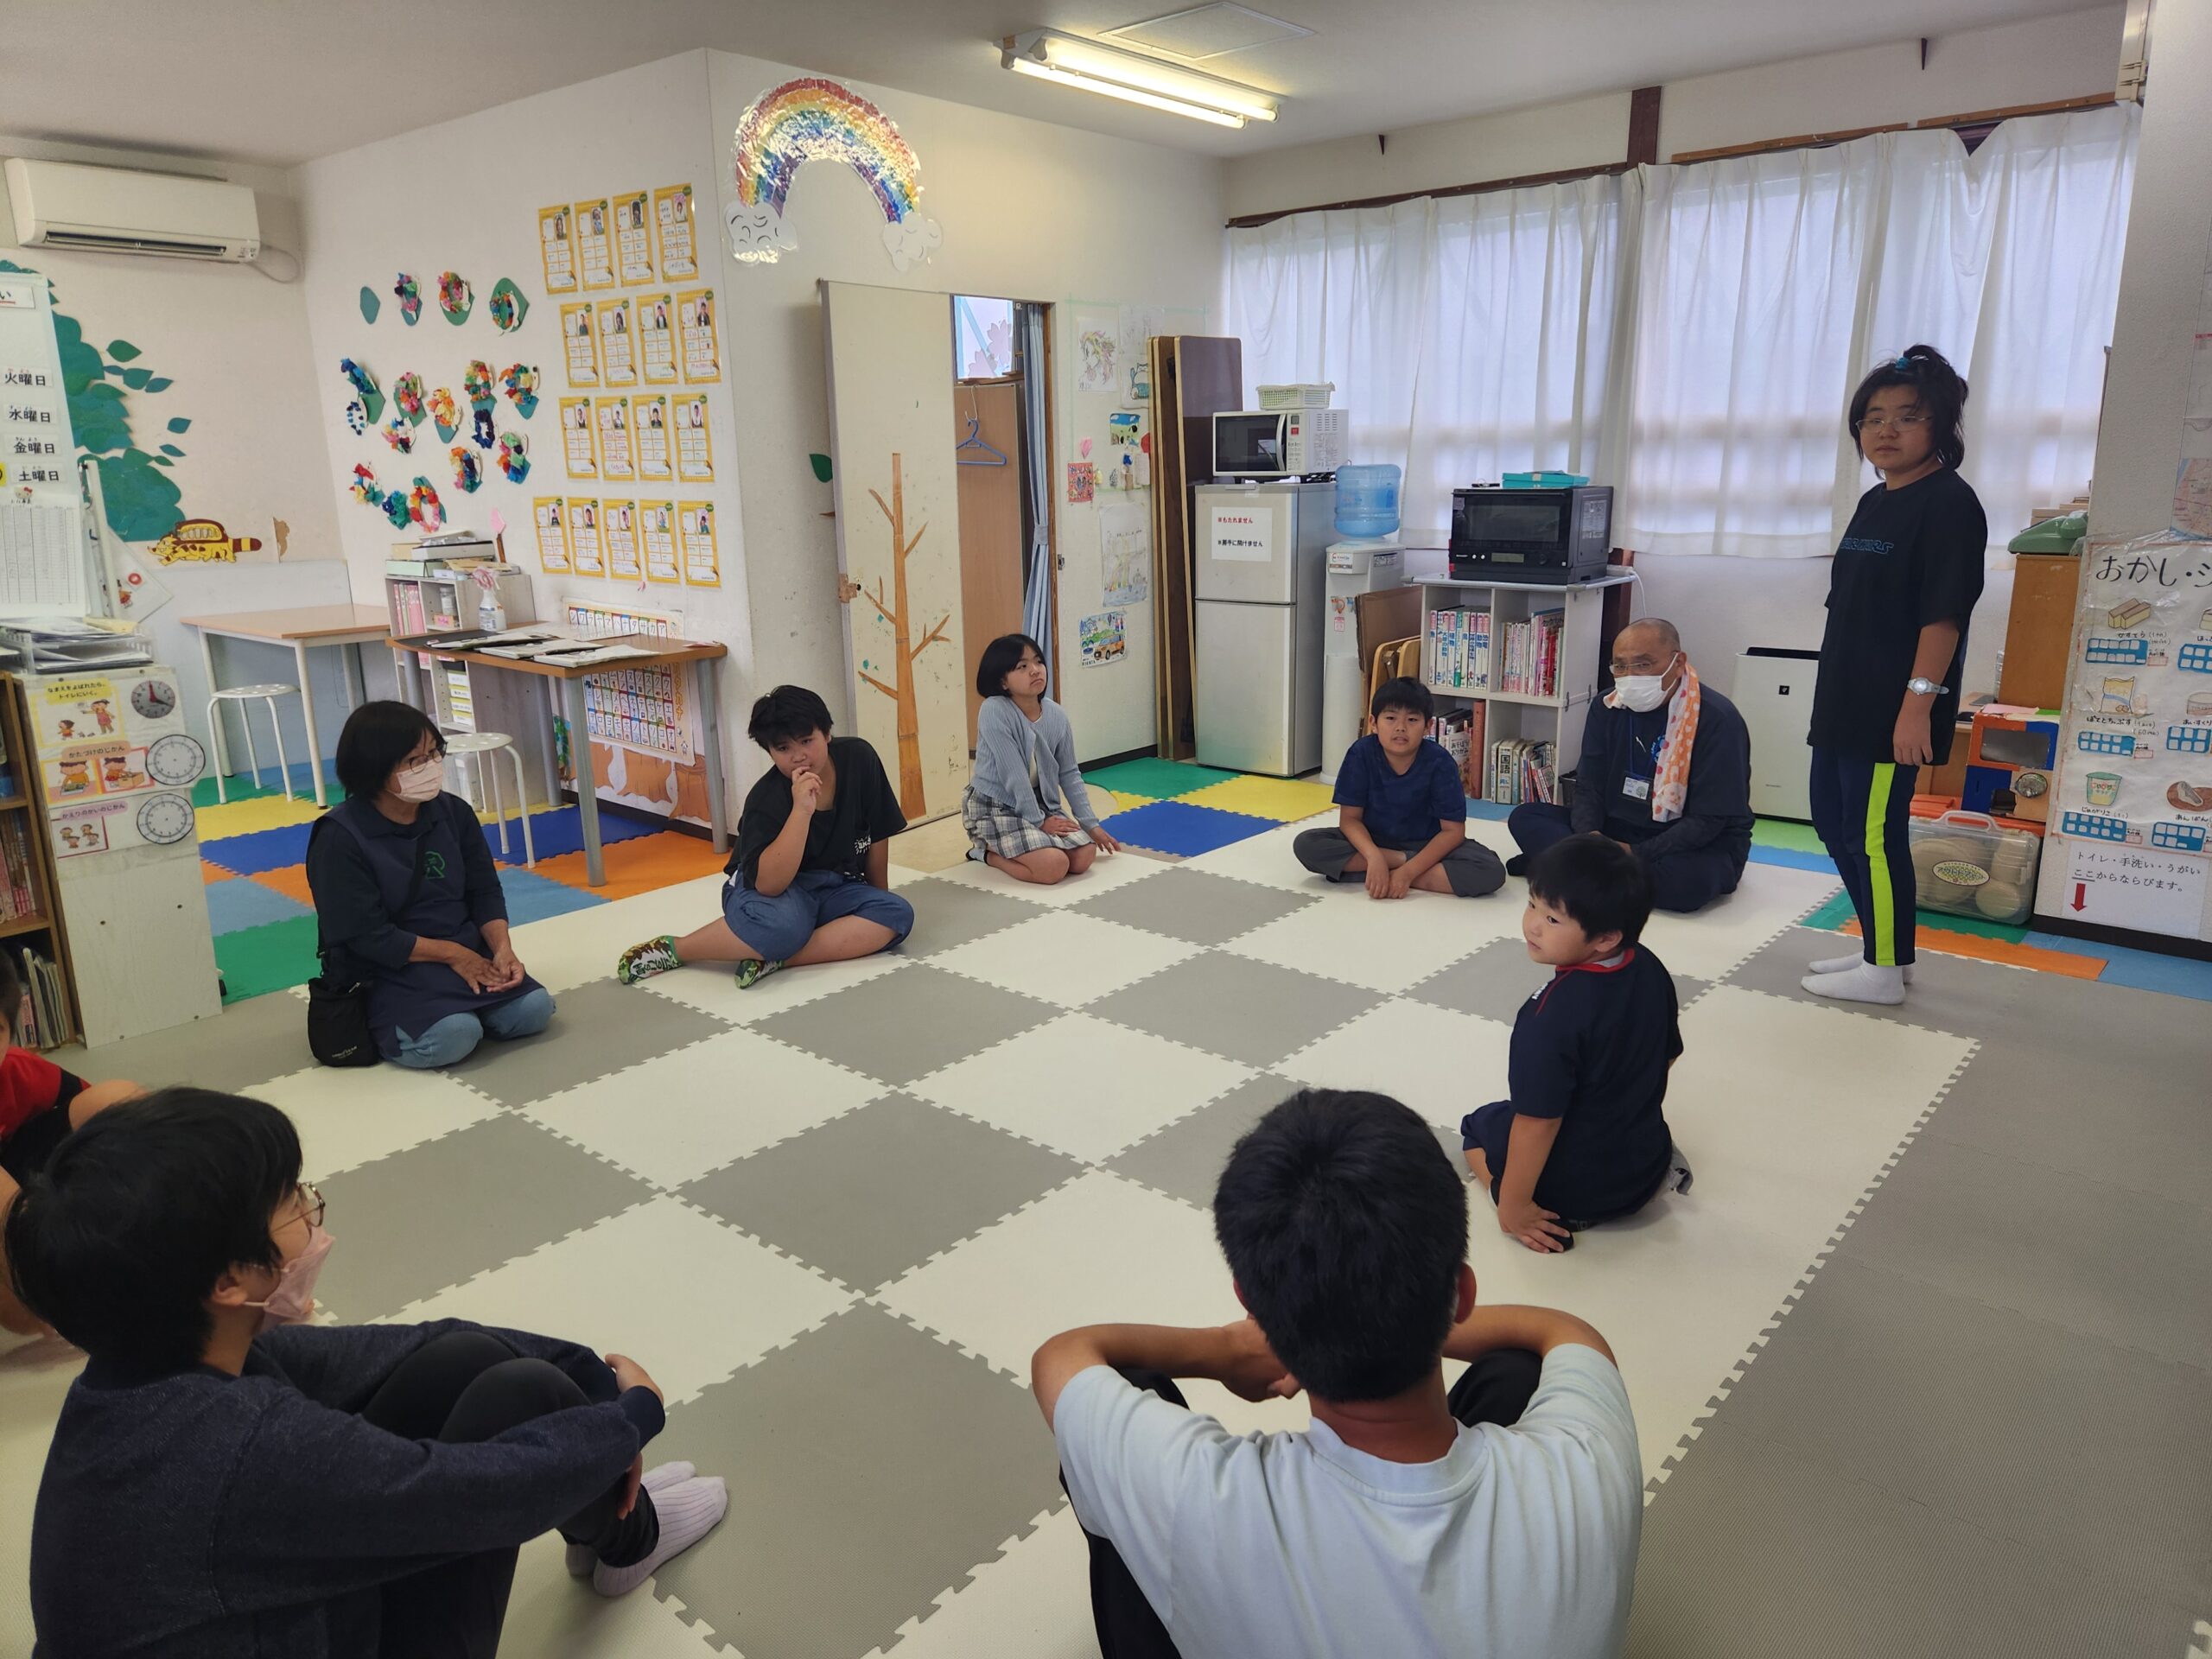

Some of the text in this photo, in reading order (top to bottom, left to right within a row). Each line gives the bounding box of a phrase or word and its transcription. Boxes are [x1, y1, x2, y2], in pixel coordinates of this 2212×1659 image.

[4, 374, 46, 386] 火曜日
[9, 409, 51, 423] 水曜日
[14, 442, 55, 454] 金曜日
[19, 470, 60, 481] 土曜日
[68, 746, 125, 759] かたづけのじかん
[62, 804, 126, 819] かえりのかいのじかん
[2077, 852, 2201, 874] トイレ・手洗い・うがい
[2074, 869, 2183, 892] ここからならびます。
